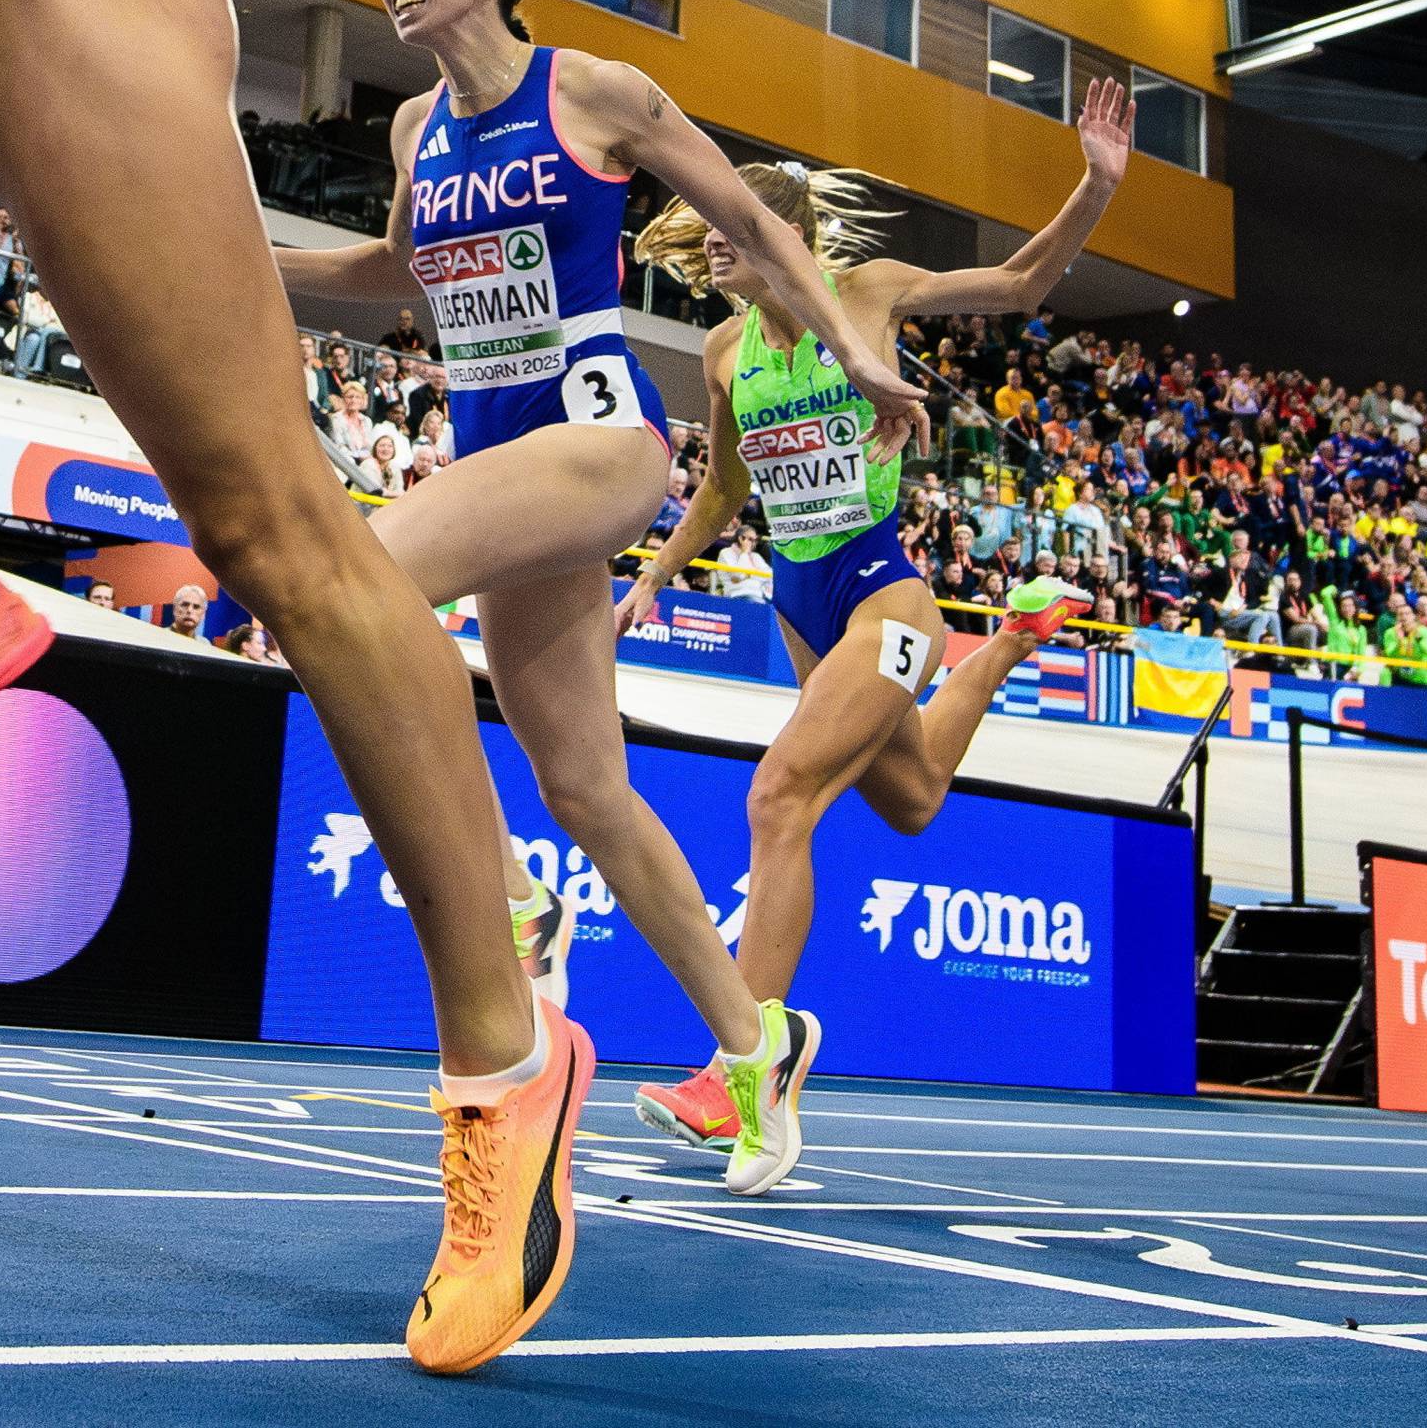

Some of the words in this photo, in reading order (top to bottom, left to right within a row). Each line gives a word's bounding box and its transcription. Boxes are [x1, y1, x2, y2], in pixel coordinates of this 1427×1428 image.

[415, 243, 502, 280] SPAR
[431, 278, 550, 330] LIBERMAN
[479, 338, 524, 356] CLEAN
[522, 353, 561, 375] 2025
[581, 370, 618, 419] 3
[740, 425, 823, 458] SPAR
[753, 453, 860, 494] HORVAT
[73, 484, 129, 515] Moving
[834, 509, 867, 526] 2025
[895, 634, 915, 677] 5
[1002, 966, 1033, 982] YOUR
